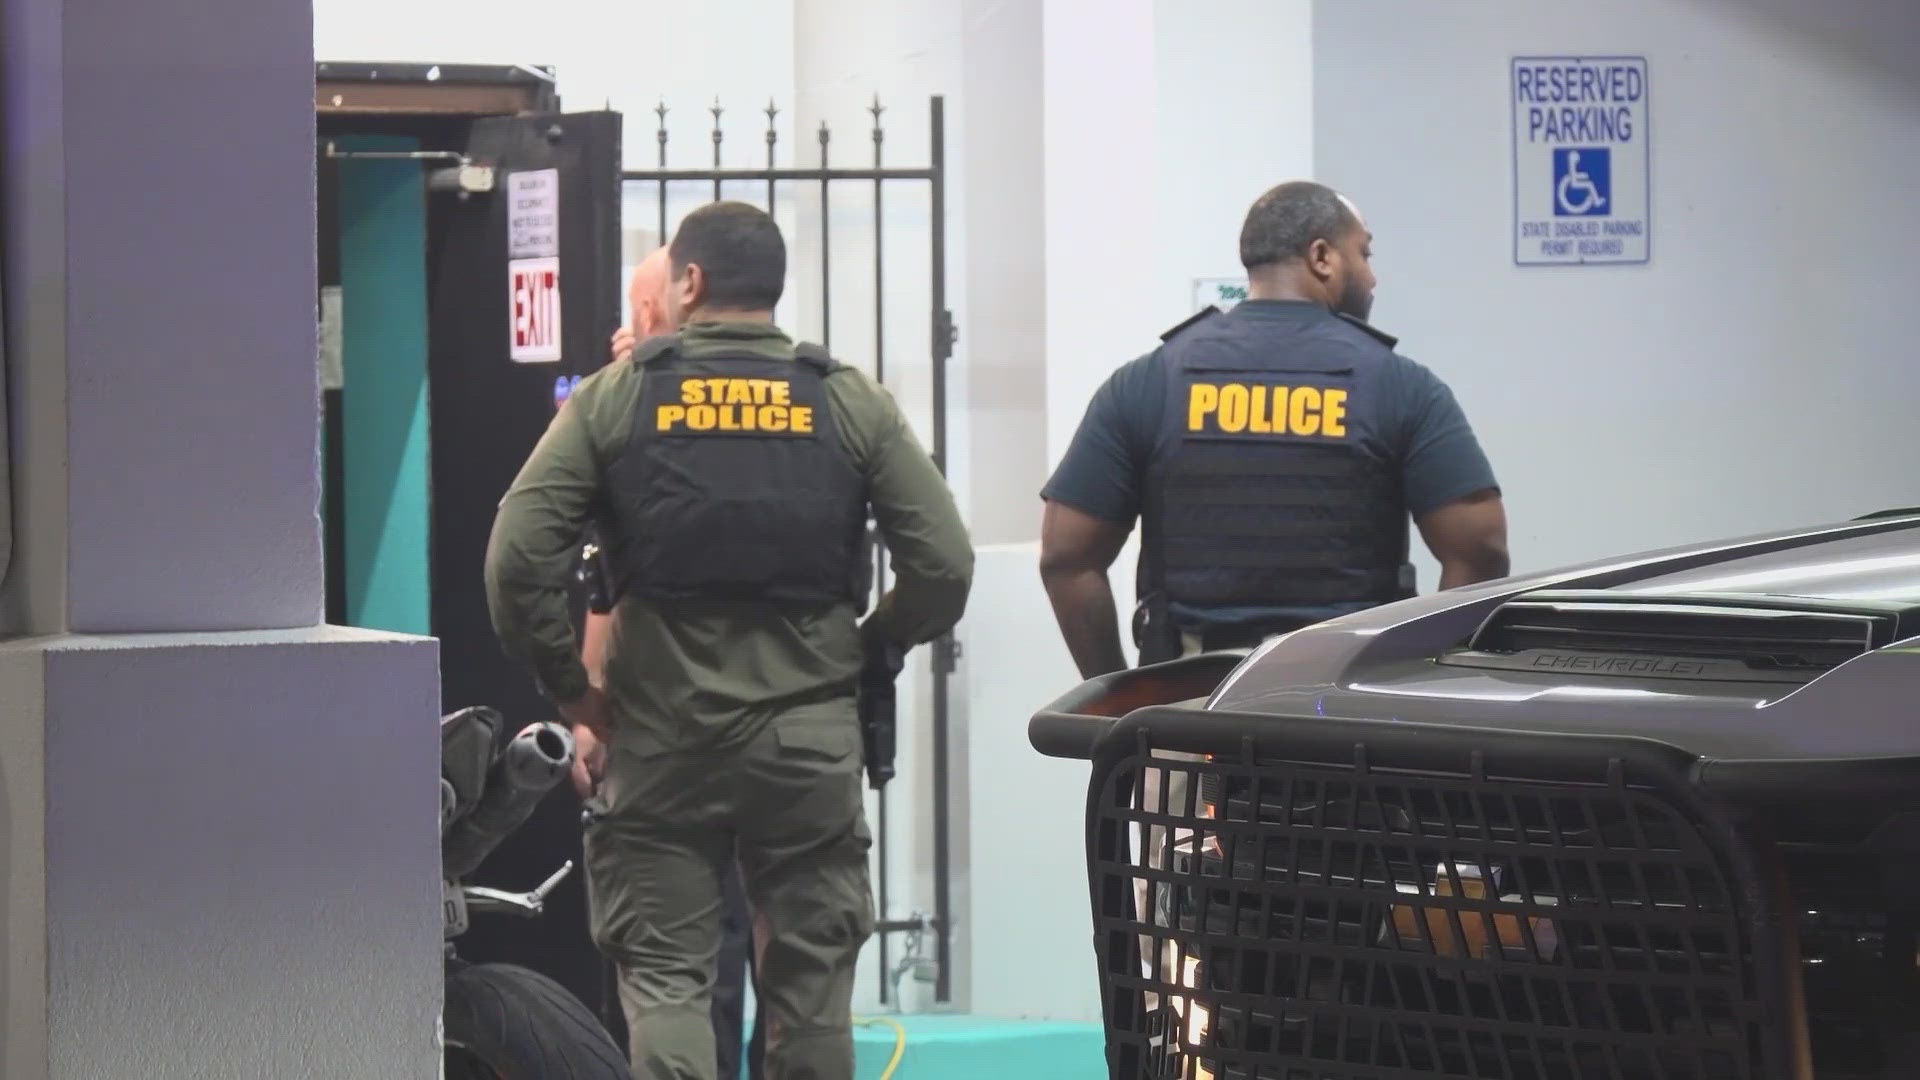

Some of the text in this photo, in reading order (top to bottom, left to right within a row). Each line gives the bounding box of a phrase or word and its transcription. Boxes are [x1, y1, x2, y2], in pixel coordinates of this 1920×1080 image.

[1518, 66, 1642, 102] RESERVED
[1529, 106, 1632, 142] PARKING
[1522, 219, 1643, 238] STATE DISABLED PARKING
[1541, 238, 1624, 256] PERMIT REQUIRED
[515, 272, 557, 347] EXIT
[681, 378, 791, 406] STATE
[656, 404, 813, 433] POLICE
[1188, 383, 1348, 437] POLICE
[1533, 654, 1717, 675] CHEVROLET
